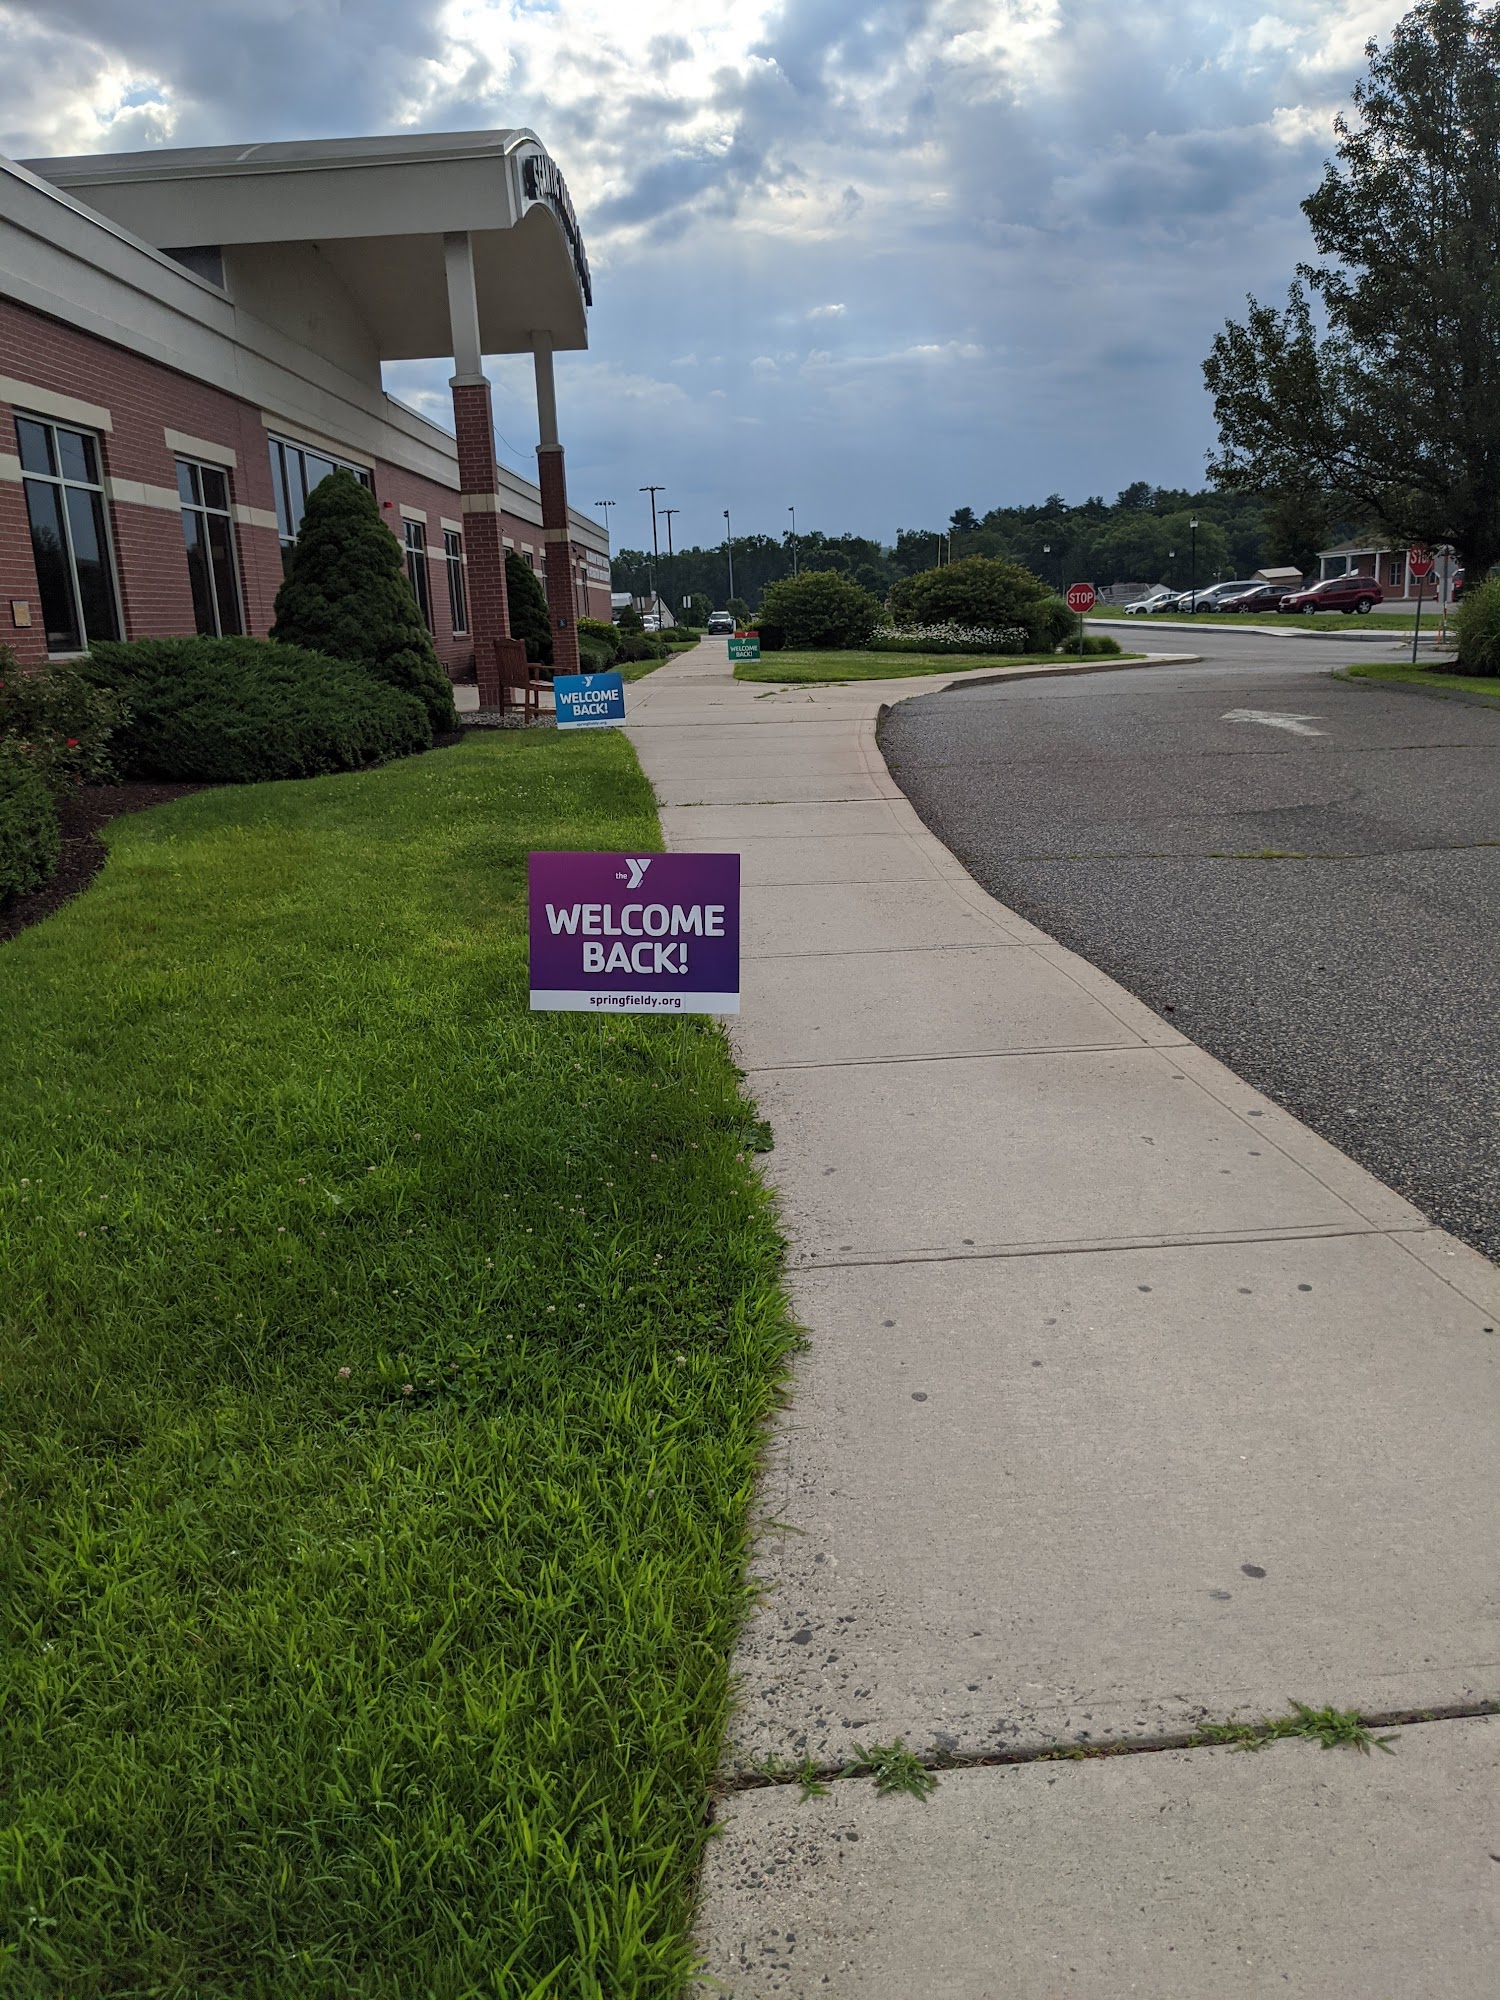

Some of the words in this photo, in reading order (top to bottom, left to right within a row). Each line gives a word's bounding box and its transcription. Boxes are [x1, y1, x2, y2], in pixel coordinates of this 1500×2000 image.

[1410, 549, 1434, 564] STO
[1069, 592, 1093, 604] STOP
[559, 689, 619, 705] WELCOME
[572, 702, 609, 716] BACK!
[615, 871, 628, 880] the
[545, 903, 725, 937] WELCOME
[582, 941, 689, 975] BACK!
[590, 995, 681, 1008] springfieldy.org
